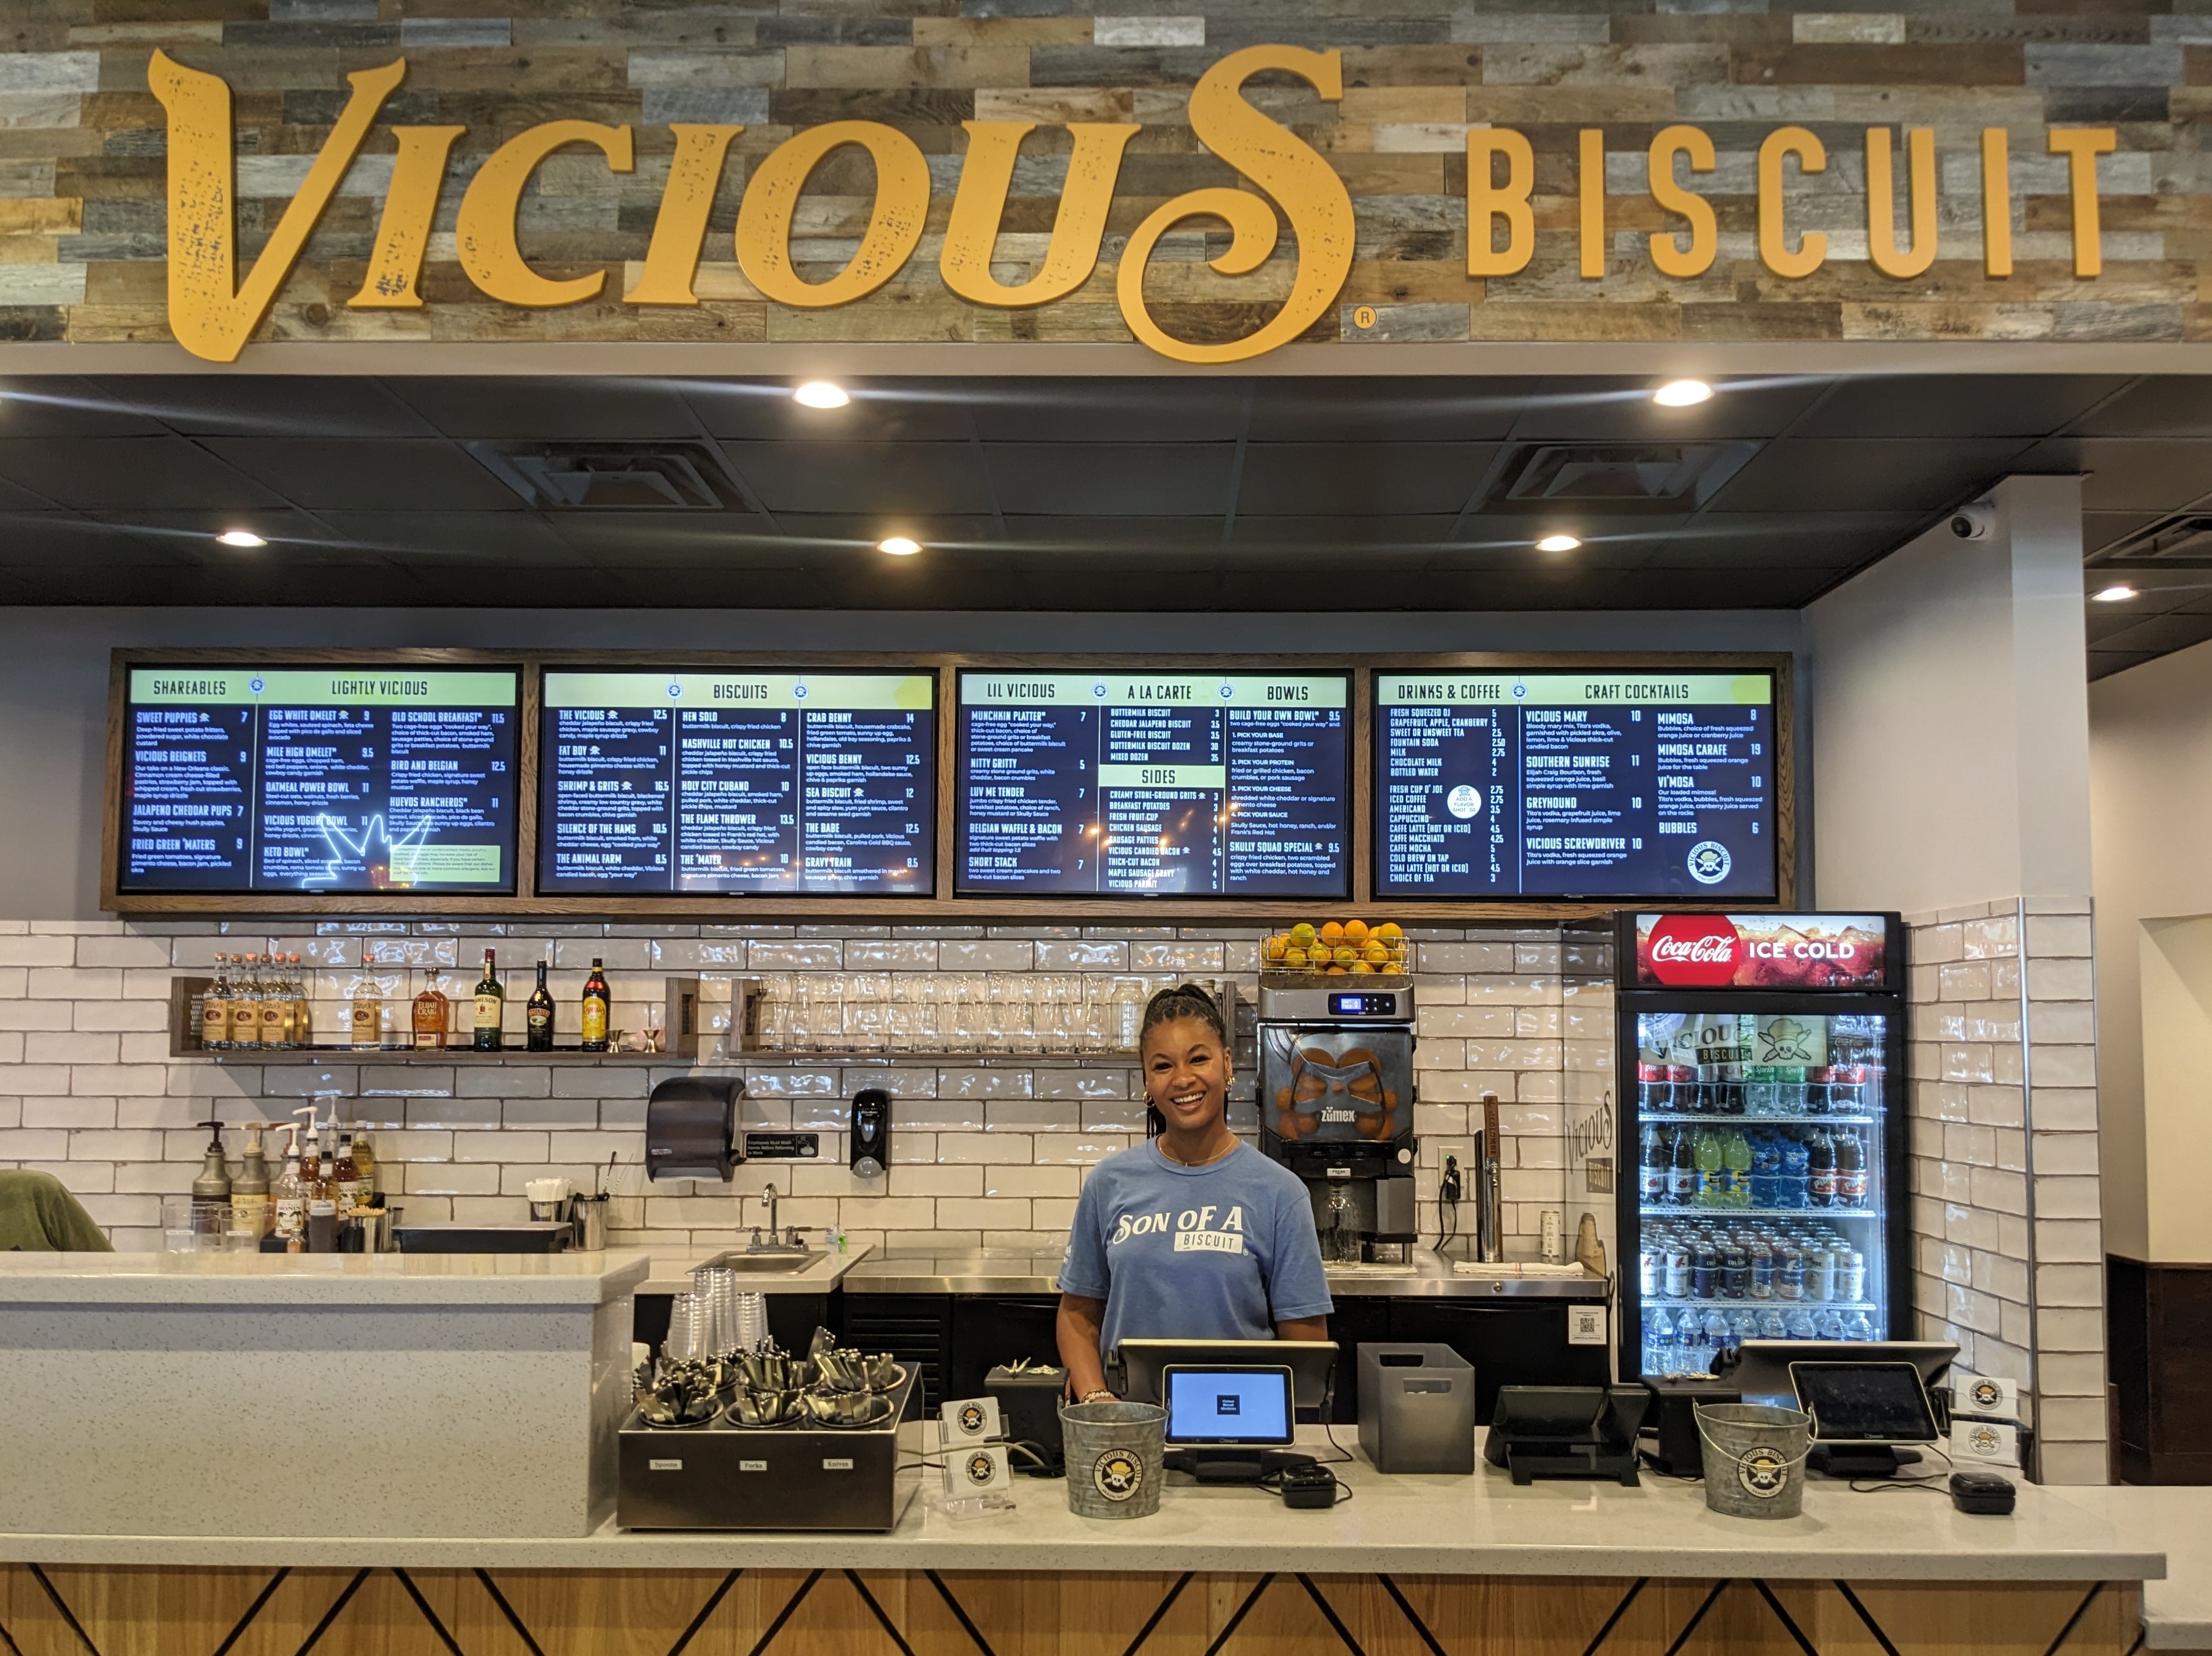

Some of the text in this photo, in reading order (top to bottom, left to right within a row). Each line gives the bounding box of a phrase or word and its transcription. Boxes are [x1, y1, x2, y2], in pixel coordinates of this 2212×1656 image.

[1466, 125, 2117, 279] BISCUIT
[154, 680, 226, 695] SHAREABLES
[332, 680, 428, 695] LIGHTLY VICIOUS
[714, 685, 768, 698] BISCUITS
[988, 683, 1054, 698] LIL VICIOUS
[1128, 685, 1191, 699] A LA CARTE
[1267, 686, 1308, 700] BOWLS
[1398, 685, 1500, 698] DRINKS & COFFEE
[1585, 685, 1688, 698] CRAFT COCKTAILS
[136, 712, 247, 723] SWEET PUPPIES 7
[559, 710, 667, 720] THE VICIOUS 12.5
[683, 711, 786, 722] HEN SOLO 8
[1658, 710, 1756, 724] MIMOSA 8
[683, 739, 793, 749] NASHVILLE HOT CHICKEN 10.5
[1390, 738, 1420, 746] FOUNTAIN
[1492, 739, 1506, 747] 2.50
[135, 751, 246, 763] VICIOUS BEIGNETS 9
[1211, 754, 1218, 762] 35
[1492, 749, 1505, 757] 2.75
[391, 761, 505, 771] BIRD AND BELGIAN 12.5
[971, 758, 1085, 770] NITTY GRITTY 5
[1526, 756, 1639, 767] SOUTHERN SUNRISE 11
[1142, 770, 1176, 784] SIDES
[806, 788, 914, 798] SEA BISCUIT 12
[970, 787, 1085, 799] LUV ME TENDER 7
[1526, 797, 1641, 809] GREYHOUND 10
[1659, 822, 1758, 834] BUBBLES 6
[132, 838, 154, 850] FRIED
[156, 839, 180, 850] GREEN
[236, 838, 243, 849] 9
[1390, 854, 1405, 862] COLD
[1408, 854, 1426, 862] BREW
[1490, 854, 1495, 863] 5
[1689, 842, 1730, 867] VICIOUS BISCUIT
[969, 857, 1084, 870] SHORT STACK 7
[1652, 935, 1737, 963] Coca-Cola
[1749, 942, 1855, 959] ICE COLD
[1756, 1066, 1774, 1074] Sprit
[1589, 1162, 1610, 1189] BISCUIT
[1221, 1206, 1244, 1231] A
[1184, 1235, 1234, 1250] BISCUIT
[1971, 1380, 1986, 1396] VICIOUS
[1095, 1451, 1142, 1484] VICIOUS BISCUIT
